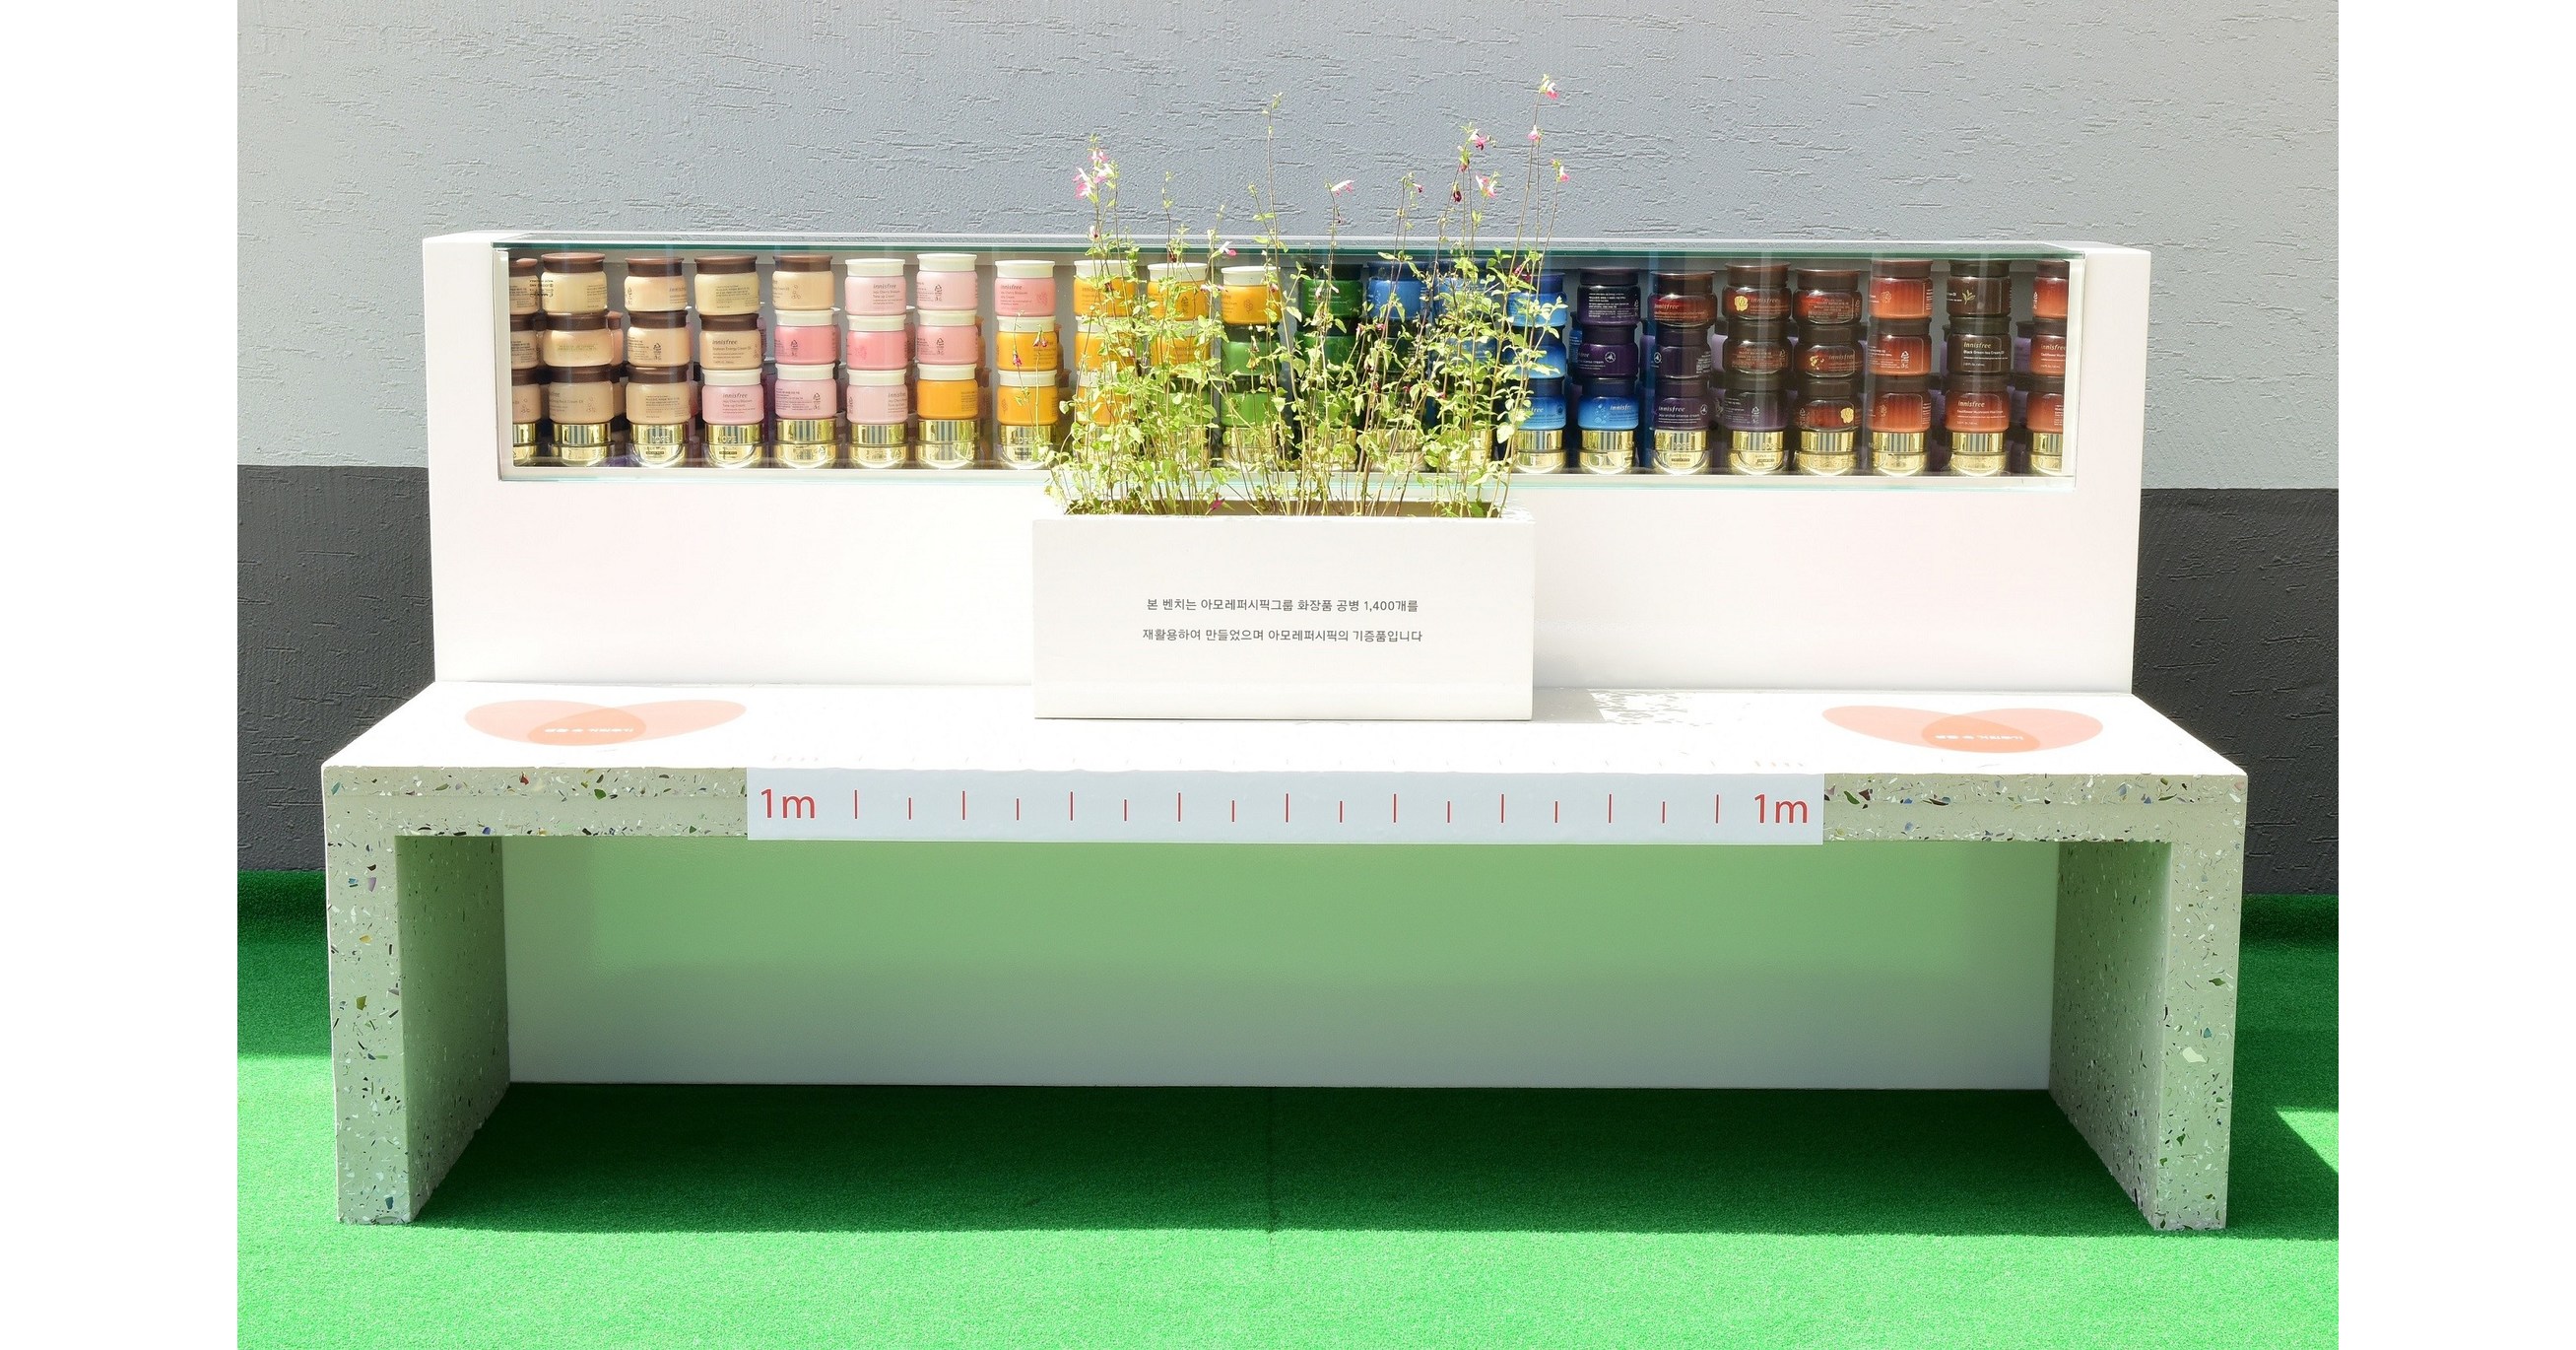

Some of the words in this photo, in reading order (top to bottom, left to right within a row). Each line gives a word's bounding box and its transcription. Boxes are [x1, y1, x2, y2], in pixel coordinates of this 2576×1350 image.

[1147, 598, 1158, 610] 본
[1162, 598, 1197, 611] 벤치는
[1201, 598, 1293, 612] 아모레퍼시픽그룹
[1297, 599, 1333, 612] 화장품
[1336, 599, 1359, 612] 공병
[1364, 599, 1419, 613] 1,400개를
[1143, 629, 1201, 641] 재활용하여
[1206, 629, 1264, 641] 만들었으며
[1268, 629, 1349, 641] 아모레퍼시픽의
[1353, 630, 1422, 642] 기증품입니다
[760, 788, 816, 819] 1m
[1753, 793, 1808, 824] 1m
